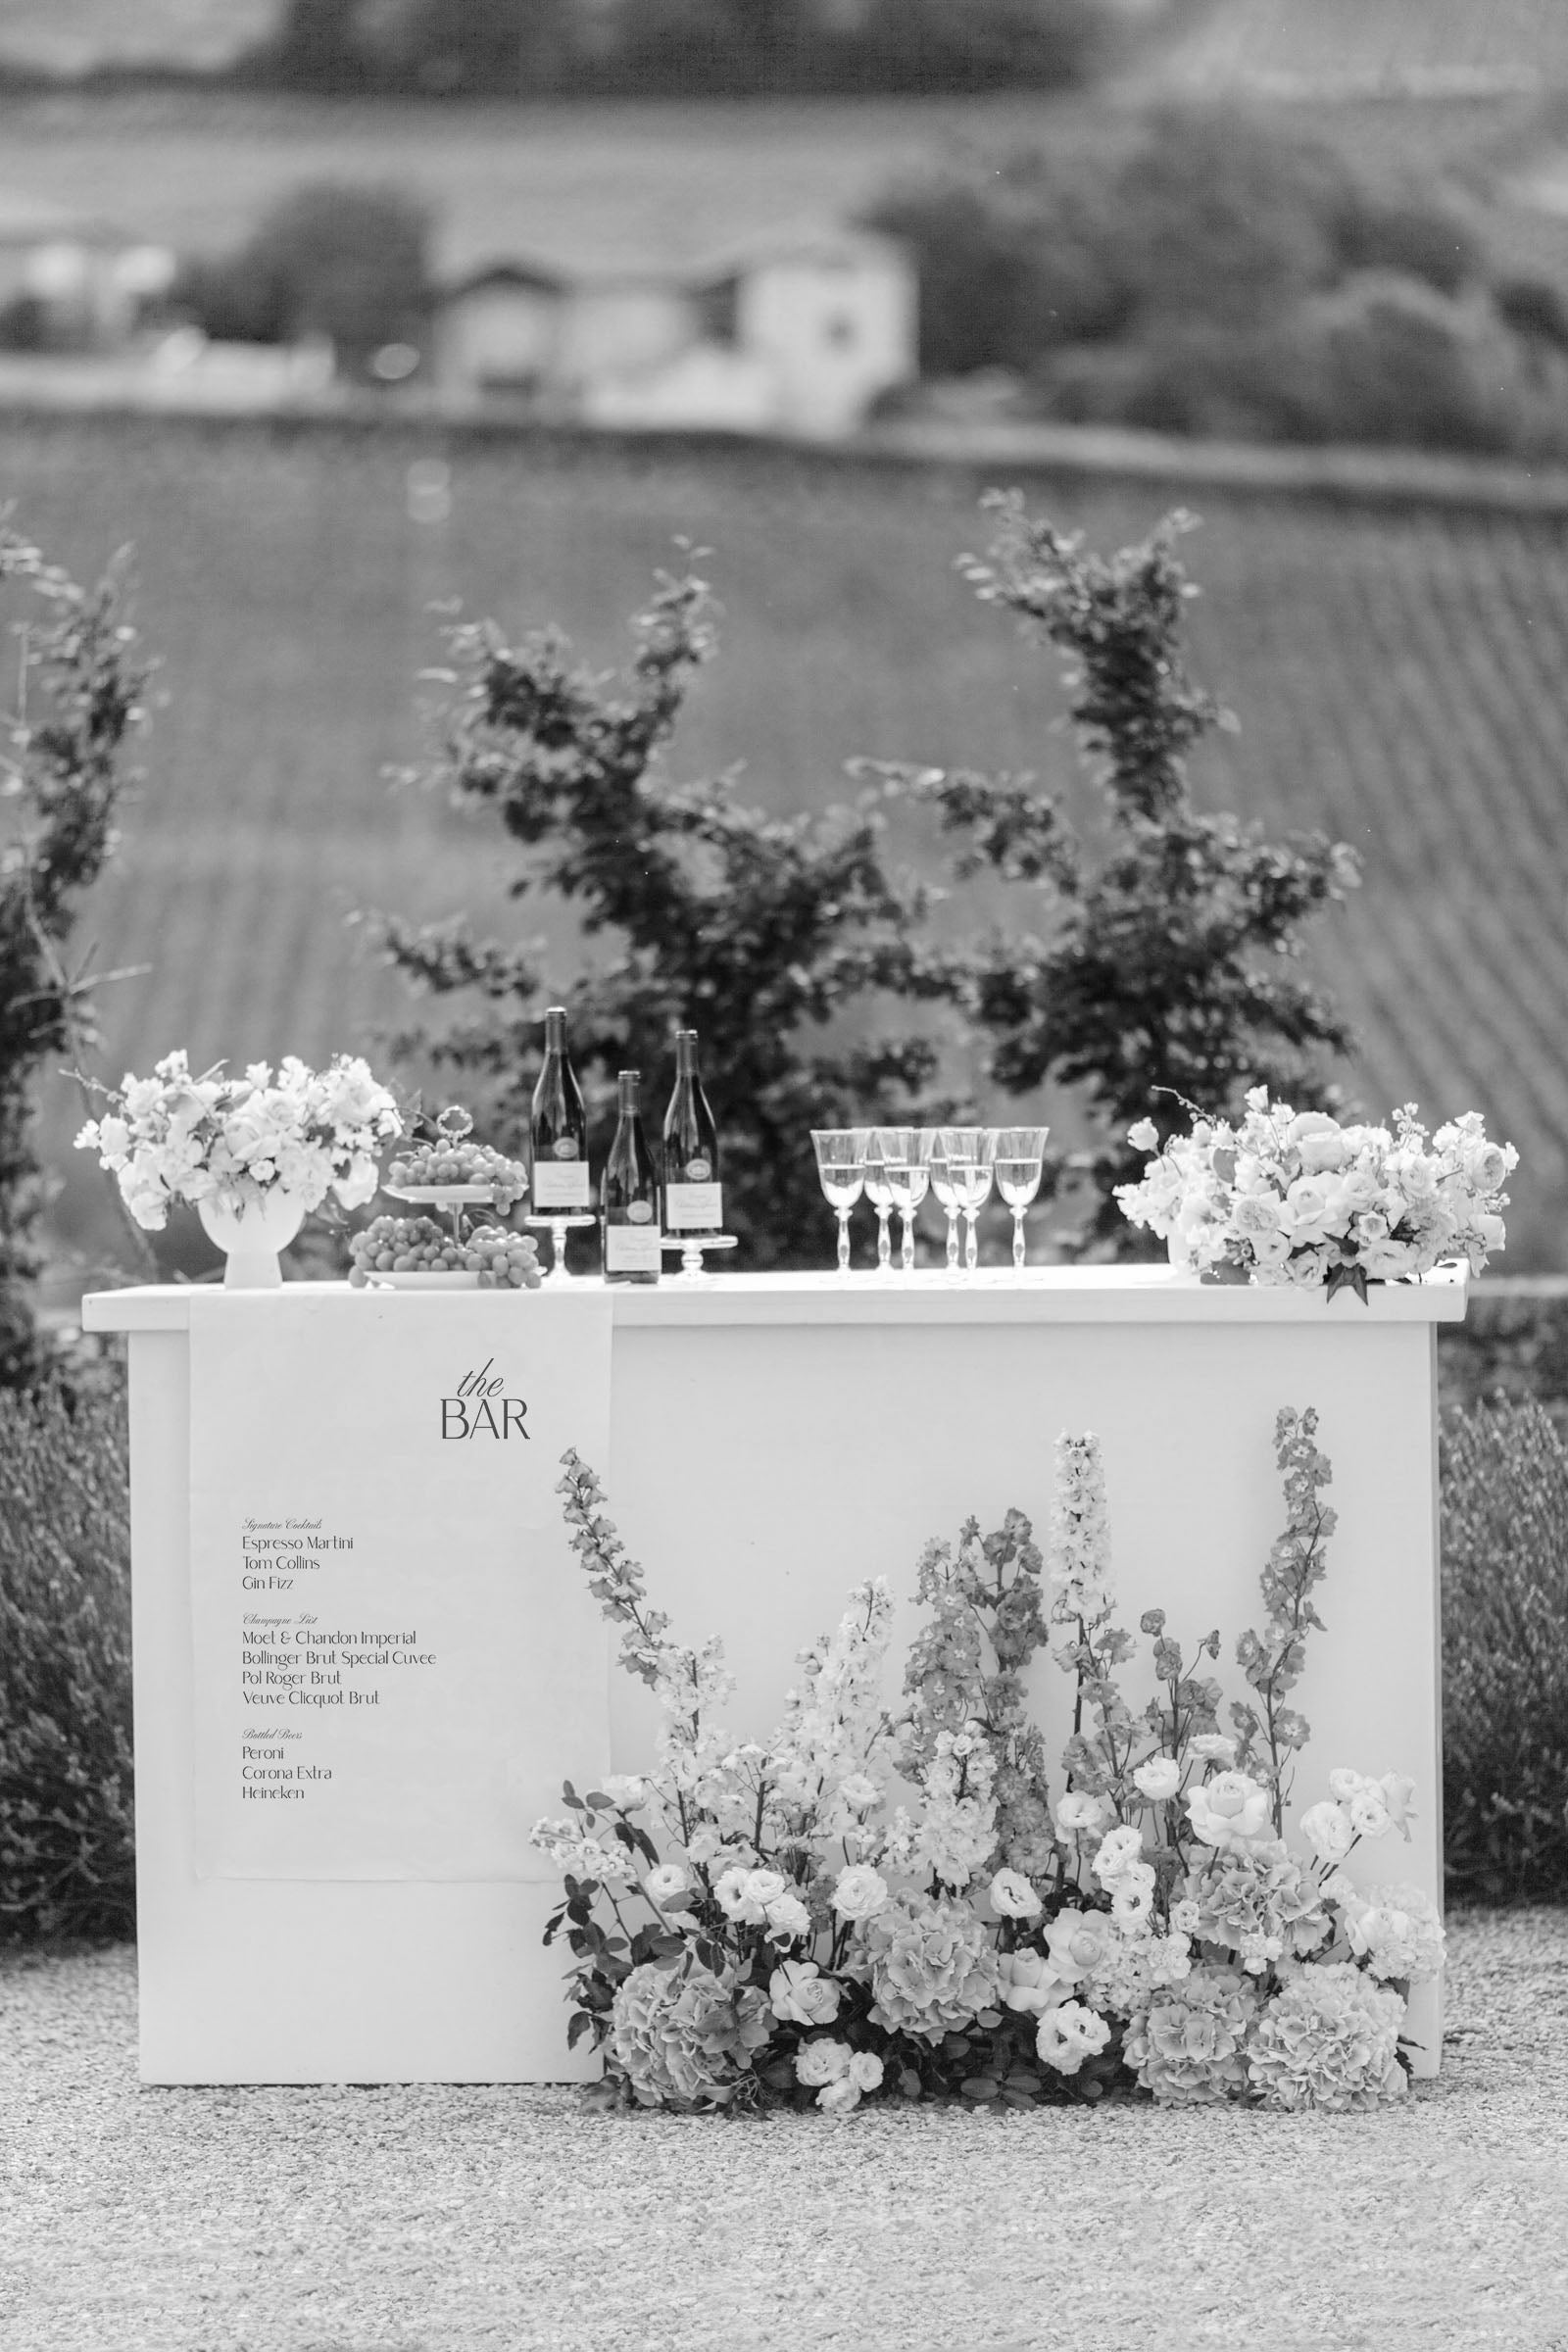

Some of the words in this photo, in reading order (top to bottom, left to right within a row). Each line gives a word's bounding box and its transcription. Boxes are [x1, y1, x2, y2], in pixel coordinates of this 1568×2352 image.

[457, 1358, 504, 1397] the
[440, 1398, 530, 1441] BAR
[242, 1518, 282, 1533] Signature
[285, 1519, 322, 1529] Cocktails
[243, 1536, 303, 1553] Espresso
[307, 1536, 353, 1550] Martini
[243, 1556, 272, 1570] Tom
[276, 1555, 320, 1570] Collins
[242, 1576, 265, 1591] Gin
[270, 1576, 293, 1590] Fizz
[243, 1613, 292, 1628] Champagne
[295, 1613, 318, 1624] List
[280, 1631, 291, 1644] &
[296, 1631, 357, 1645] Chandon
[362, 1631, 416, 1648] Imperial
[243, 1650, 302, 1671] Bollinger
[307, 1650, 337, 1664] Brut
[341, 1650, 388, 1668] Special
[392, 1649, 436, 1664] Cuvee
[243, 1670, 262, 1686] Pol
[267, 1670, 307, 1691] Roger
[311, 1671, 342, 1685] Brut
[243, 1690, 285, 1705] Veuve
[287, 1690, 344, 1709] Clicquot
[349, 1690, 380, 1705] Brut
[242, 1728, 277, 1740] Bottled
[276, 1729, 302, 1740] Beers
[243, 1746, 283, 1759] Peroni
[242, 1765, 293, 1780] Corona
[297, 1765, 331, 1780] Extra
[243, 1785, 304, 1800] Heineken
